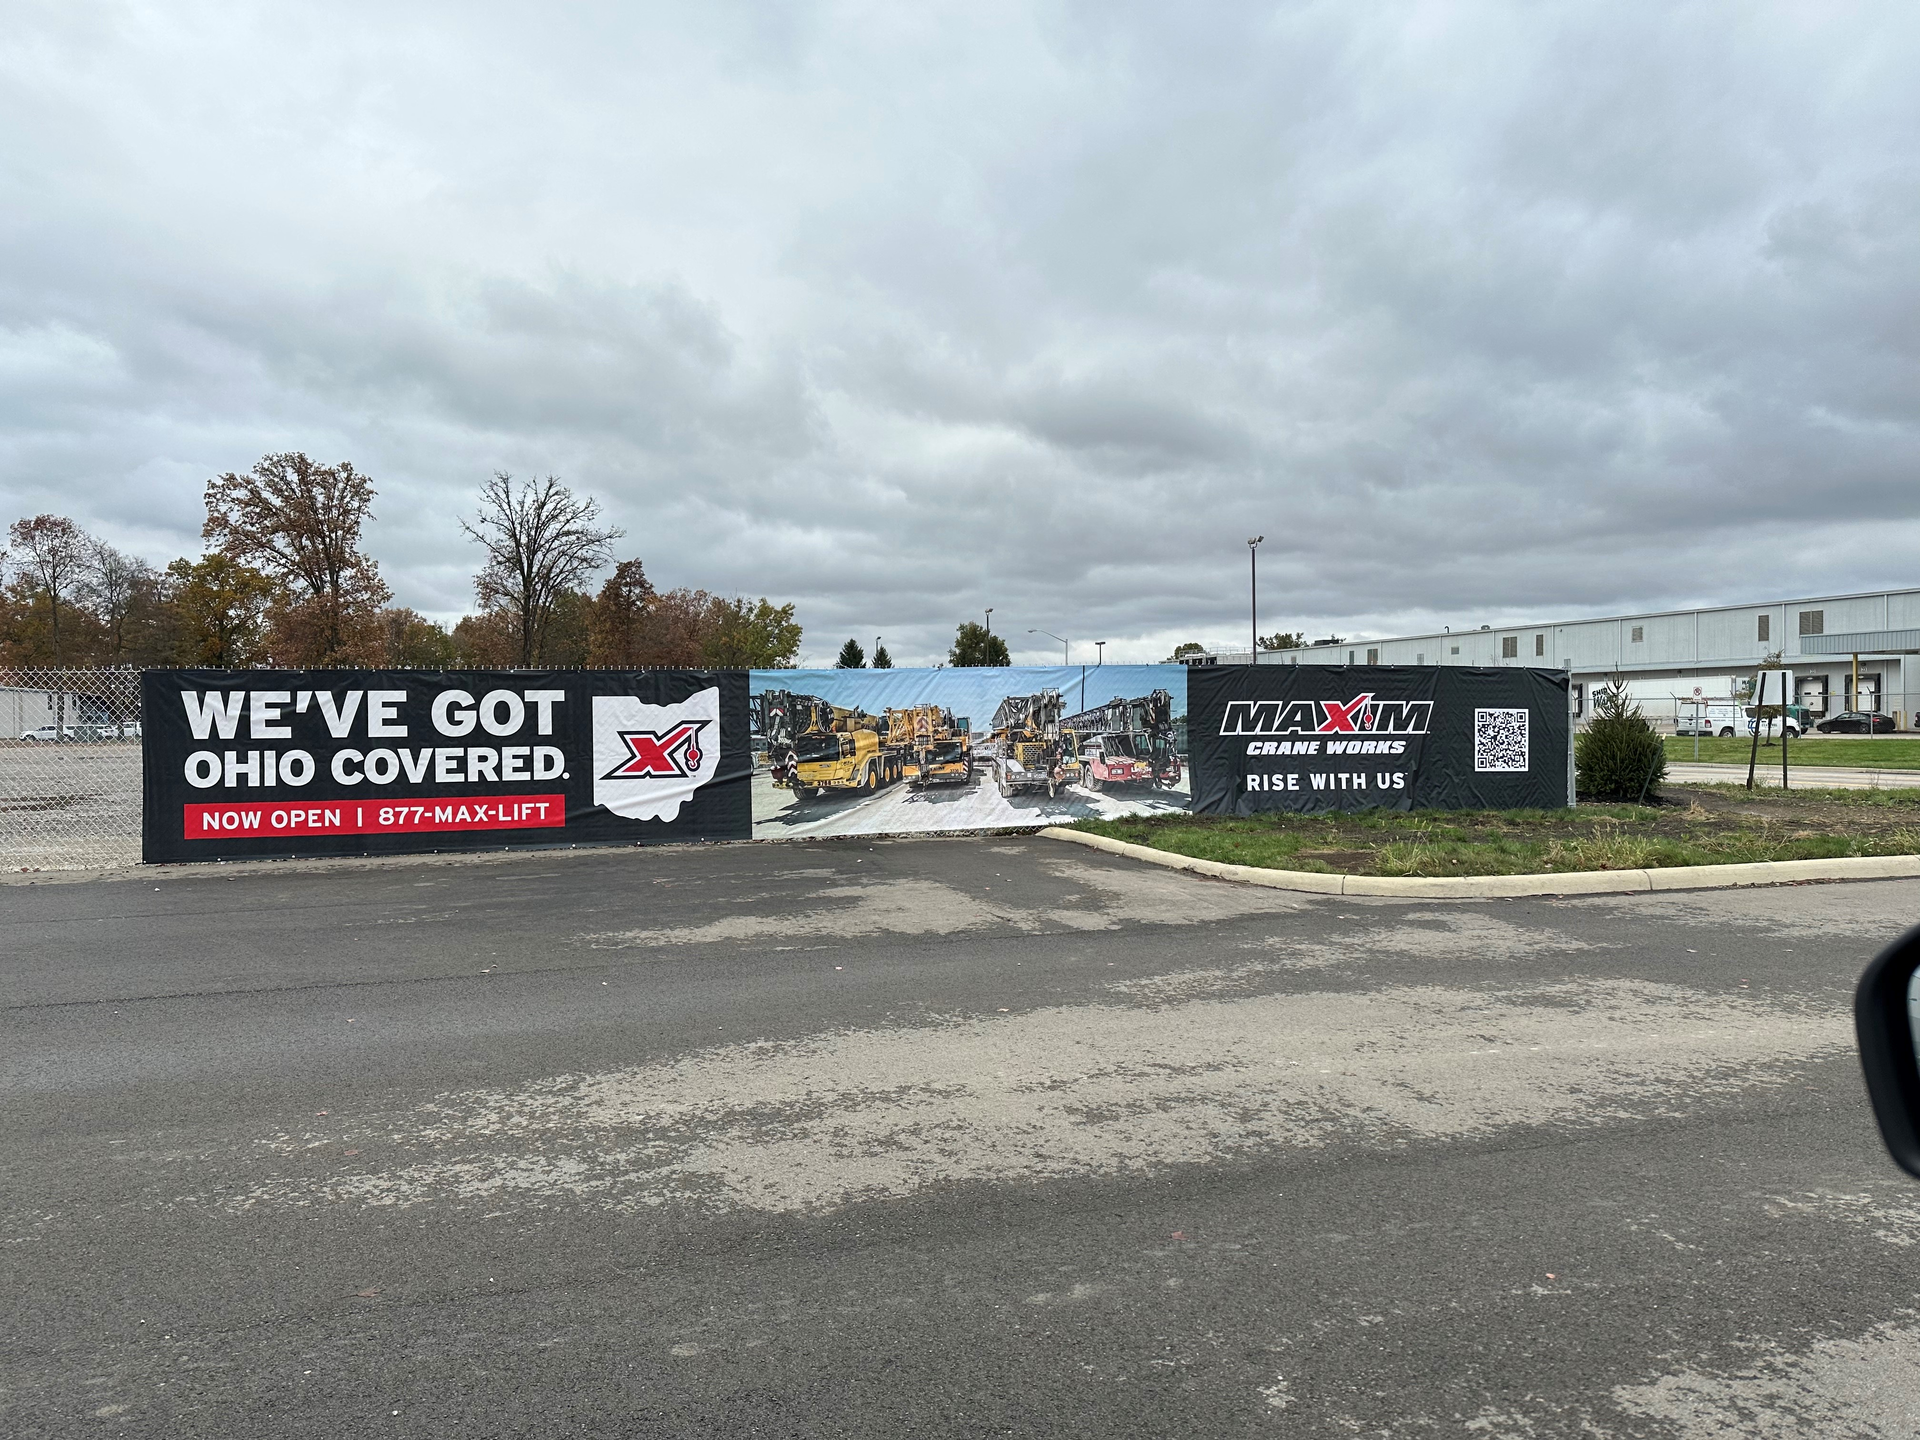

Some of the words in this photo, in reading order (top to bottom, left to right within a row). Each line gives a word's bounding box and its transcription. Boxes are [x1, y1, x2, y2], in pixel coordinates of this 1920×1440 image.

[180, 690, 408, 740] WE'VE
[431, 689, 565, 738] GOT
[1219, 692, 1434, 736] MAXIM
[1246, 741, 1320, 756] CRANE
[1326, 740, 1407, 755] WORKS
[184, 749, 316, 789] OHIO
[330, 745, 570, 785] COVERED.
[1246, 773, 1300, 792] RISE
[1310, 772, 1367, 790] WITH
[1376, 772, 1405, 790] US
[202, 810, 262, 831] NOW
[270, 808, 341, 829] OPEN
[378, 802, 550, 826] 877-MAX-LIFT
